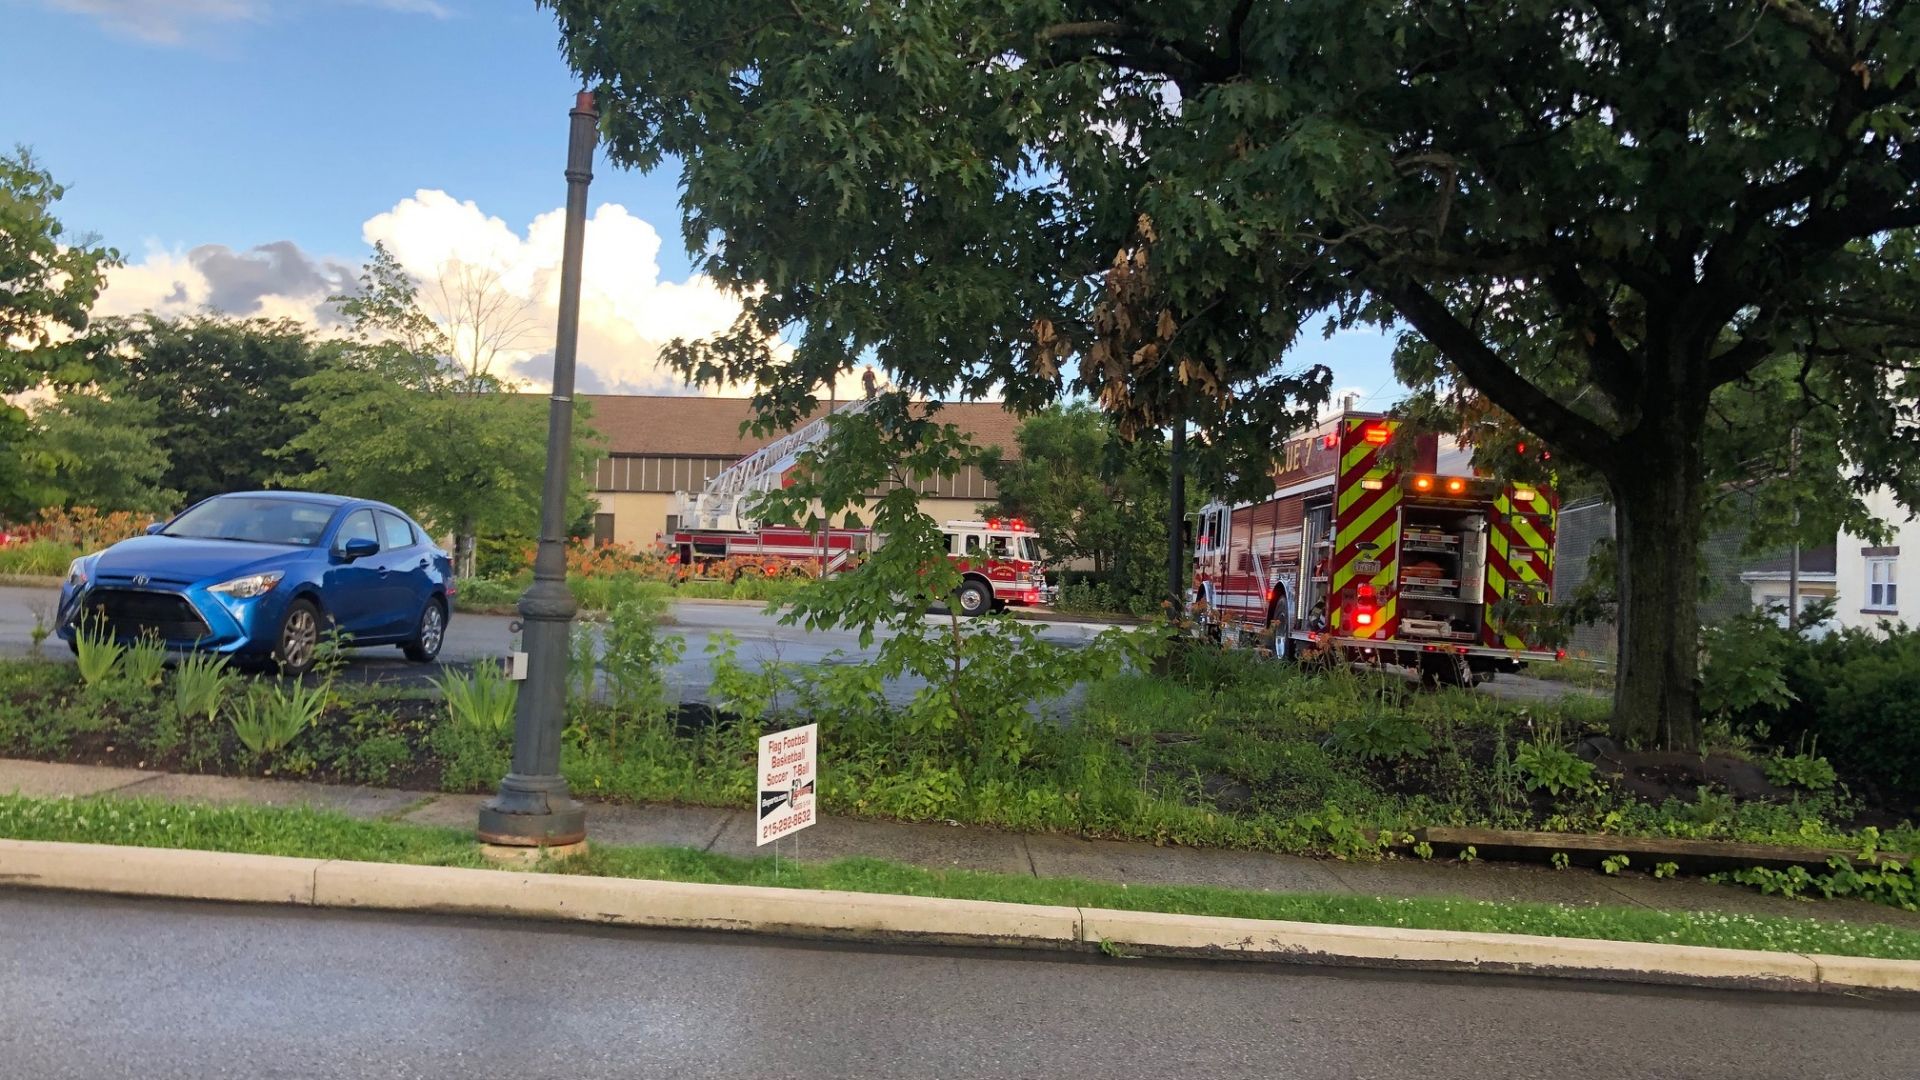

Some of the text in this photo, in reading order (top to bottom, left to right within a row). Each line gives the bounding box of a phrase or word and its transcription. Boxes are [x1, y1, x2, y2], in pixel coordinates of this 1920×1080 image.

[1305, 438, 1313, 466] 7
[768, 732, 809, 754] Flag Football
[772, 748, 806, 768] Basketball
[767, 761, 810, 786] Soccer T-Ball
[763, 809, 811, 838] 215-292-8632
